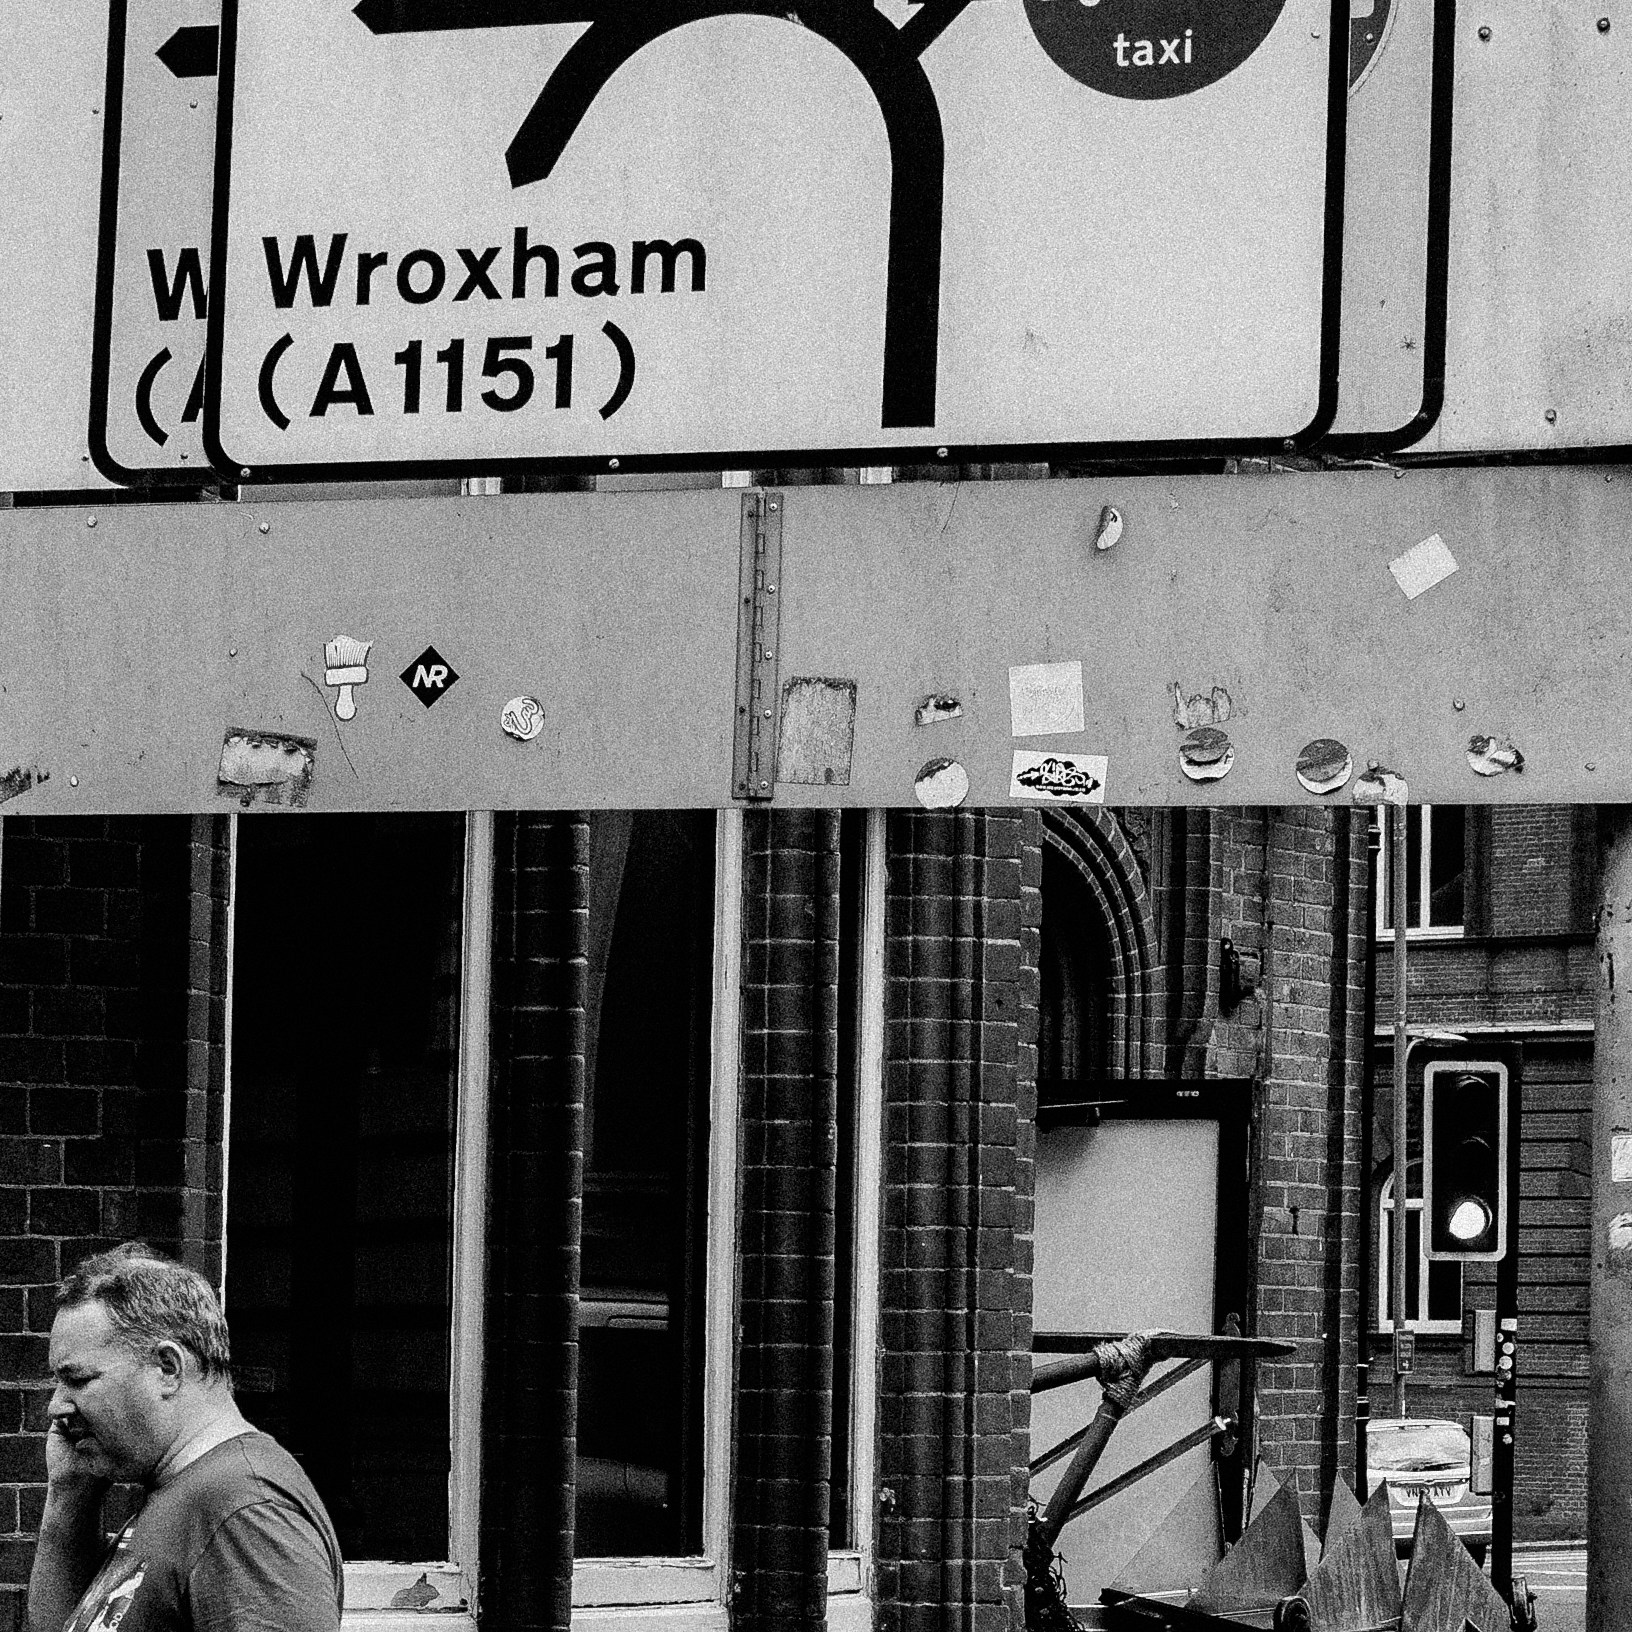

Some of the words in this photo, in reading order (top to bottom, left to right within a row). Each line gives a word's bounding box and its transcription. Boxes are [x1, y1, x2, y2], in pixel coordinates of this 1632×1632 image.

[1113, 29, 1193, 66] taxi
[262, 226, 707, 308] Wroxham
[412, 664, 449, 688] NR
